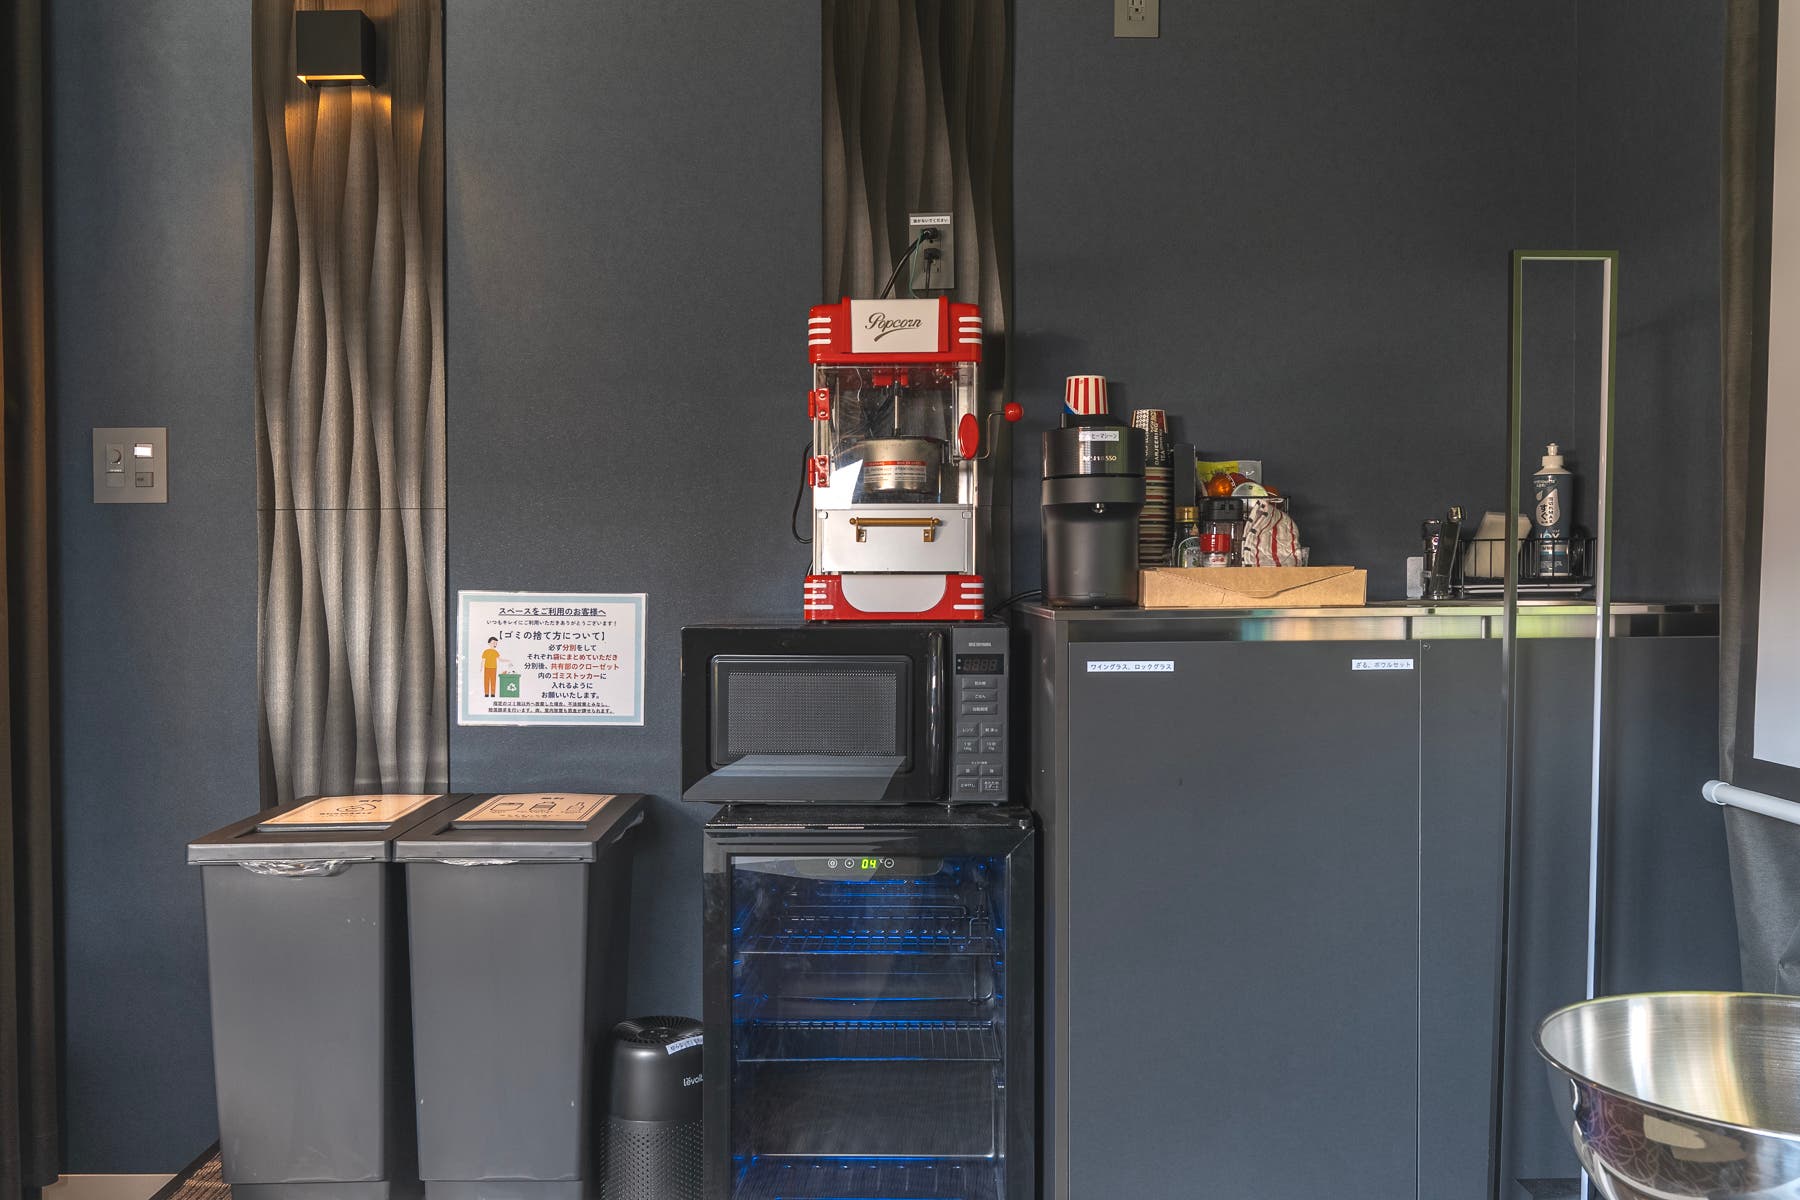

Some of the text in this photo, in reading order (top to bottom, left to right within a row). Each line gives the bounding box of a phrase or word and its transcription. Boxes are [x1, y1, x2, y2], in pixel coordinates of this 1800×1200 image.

[865, 312, 922, 332] Popcorn
[498, 607, 607, 616] スペースをご利用のお客様へ
[499, 630, 605, 641] 【ゴミの捨て方について】
[548, 644, 597, 652] 必ず分別をして
[527, 653, 619, 661] それぞれ袋にまとめていただき
[524, 662, 620, 671] 分別後、共有部のクローゼット
[1090, 663, 1172, 671] ワイングラス、ロックグラス
[537, 672, 607, 680] 内のゴミストッカーに
[541, 691, 600, 700] お願いいたします。
[861, 858, 877, 869] 04
